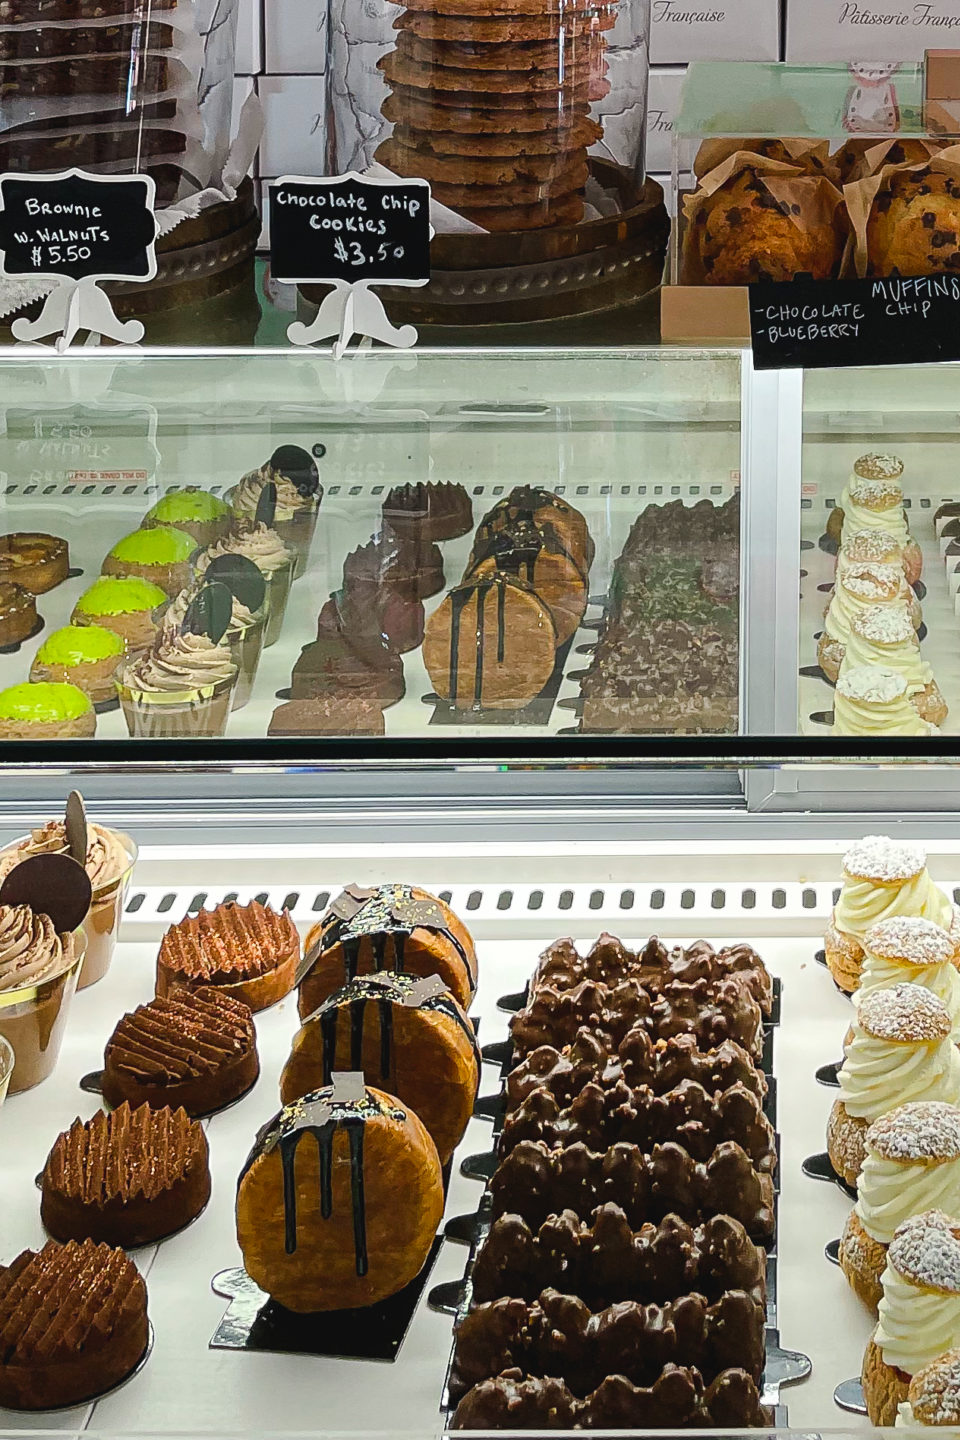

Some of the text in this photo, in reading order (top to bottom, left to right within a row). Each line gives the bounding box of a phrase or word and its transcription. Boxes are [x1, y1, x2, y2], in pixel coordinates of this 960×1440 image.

[839, 2, 909, 26] Pâtisserie
[277, 192, 420, 217] Chocolate Chip
[309, 214, 386, 235] Cookies
[334, 236, 405, 266] $3.50
[872, 276, 960, 301] MUFFINS
[886, 299, 931, 318] CHIP
